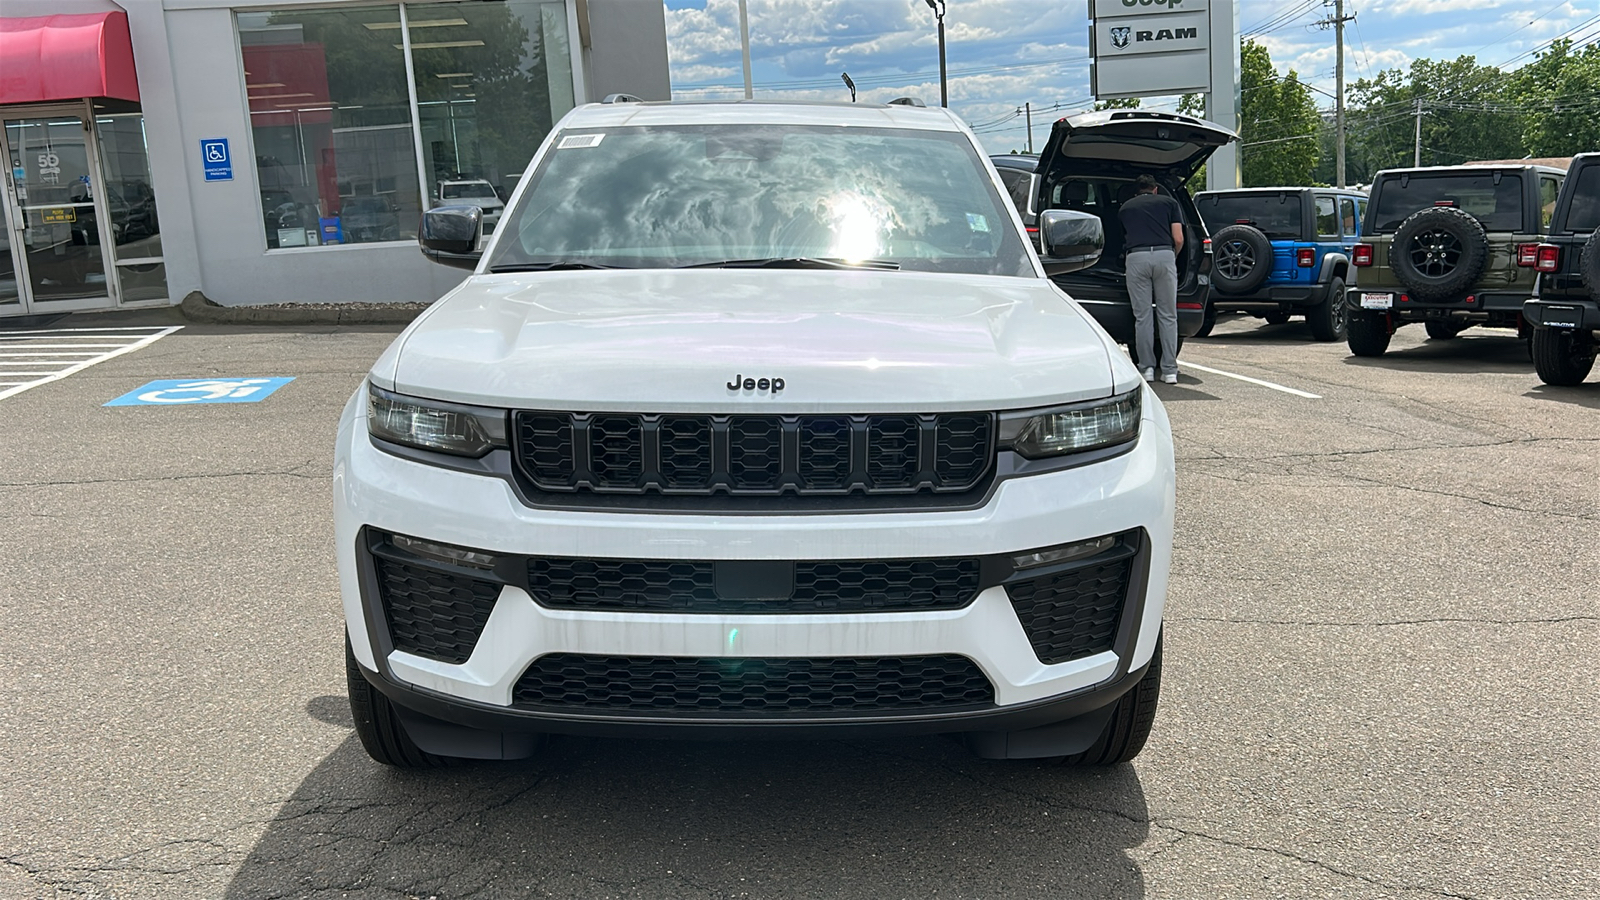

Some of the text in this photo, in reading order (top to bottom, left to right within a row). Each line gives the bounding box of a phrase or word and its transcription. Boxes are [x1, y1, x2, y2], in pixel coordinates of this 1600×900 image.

[1136, 27, 1197, 42] RAM
[38, 154, 59, 167] 50
[726, 374, 785, 394] Jeep
